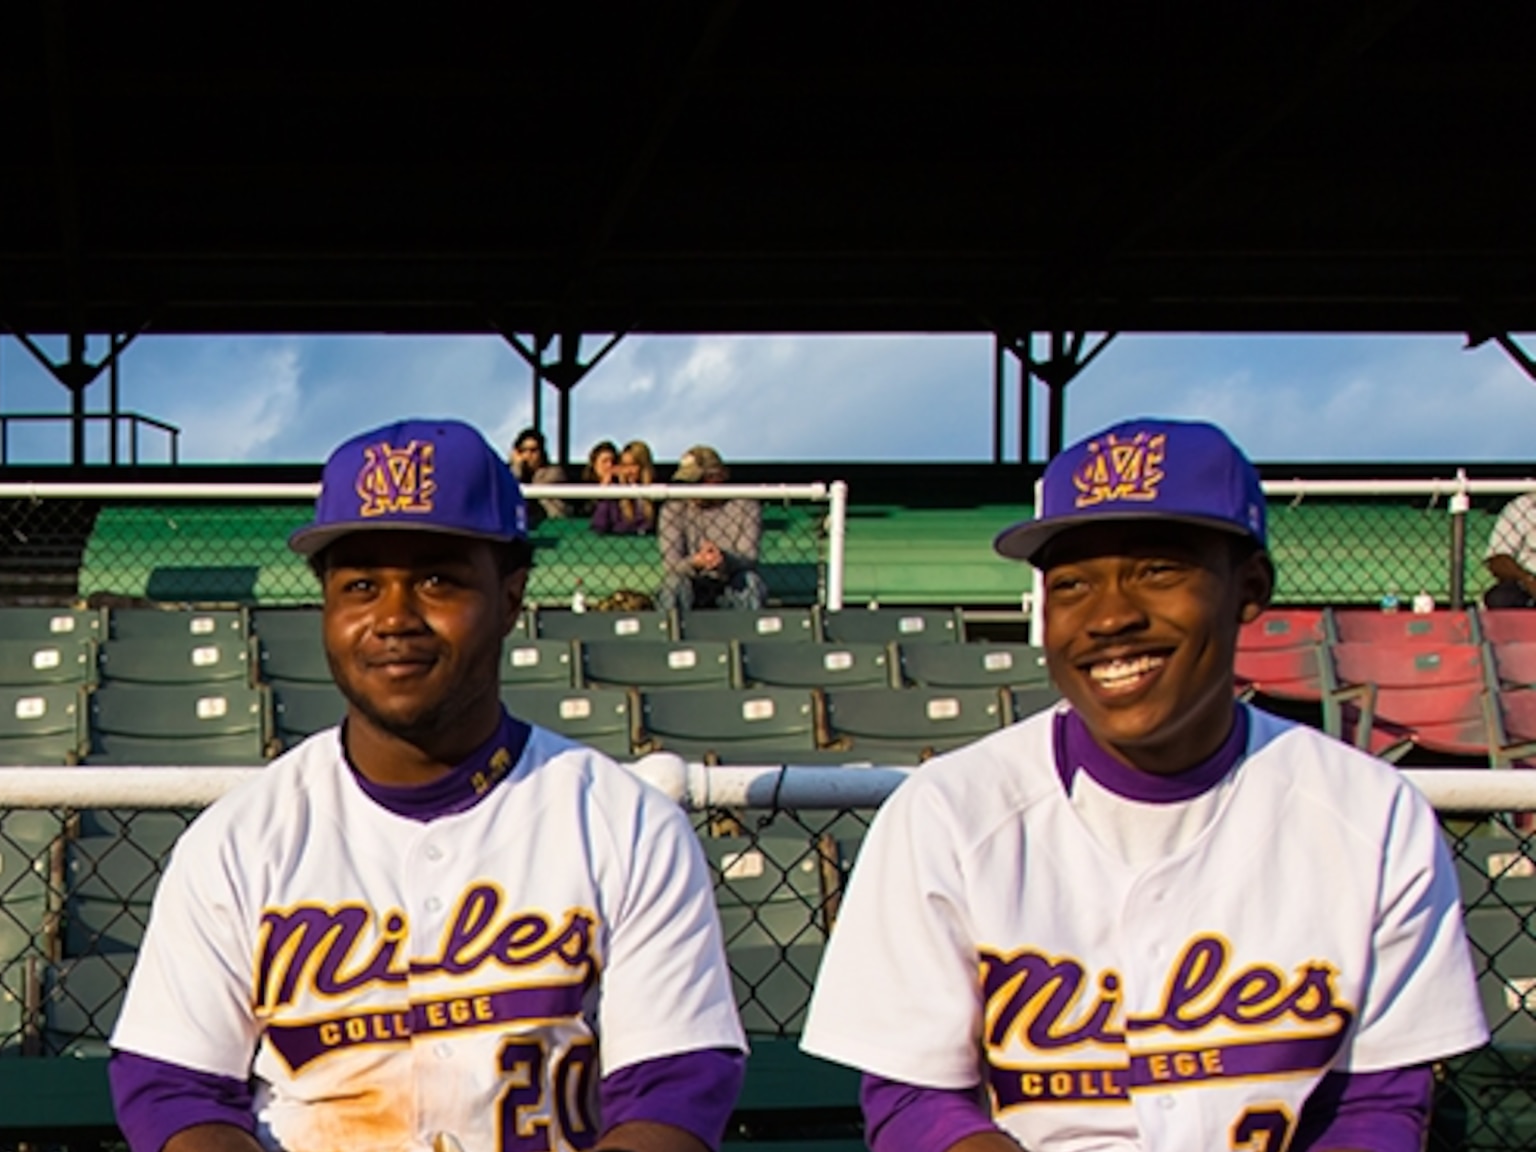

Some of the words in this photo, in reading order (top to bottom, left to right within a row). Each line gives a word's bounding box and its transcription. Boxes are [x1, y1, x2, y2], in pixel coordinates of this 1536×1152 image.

[255, 882, 598, 1014] Miles
[318, 994, 496, 1048] COLLEGE
[978, 932, 1348, 1053] Miles
[1020, 1048, 1224, 1096] COLLEGE
